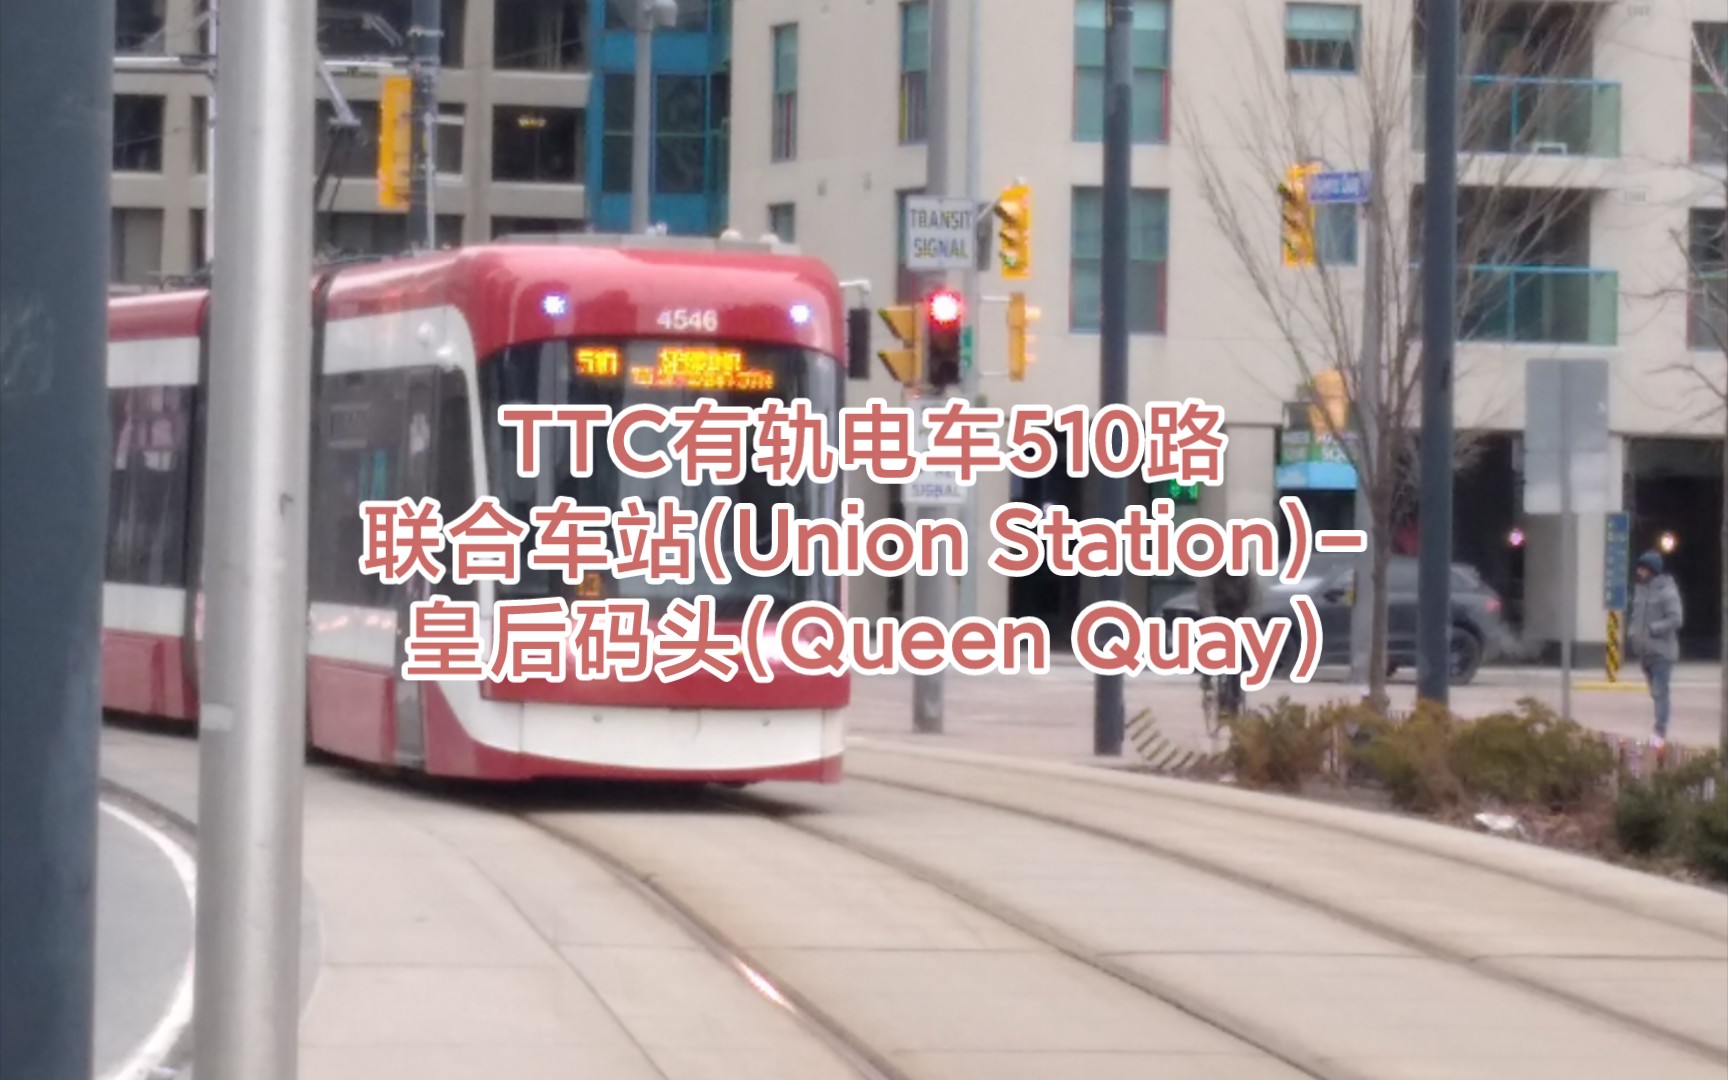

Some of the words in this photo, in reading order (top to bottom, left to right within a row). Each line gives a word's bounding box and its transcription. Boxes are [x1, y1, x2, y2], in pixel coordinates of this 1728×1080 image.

[910, 208, 973, 231] TRANSIT
[913, 237, 969, 259] SIGNAL
[656, 309, 719, 332] 4546
